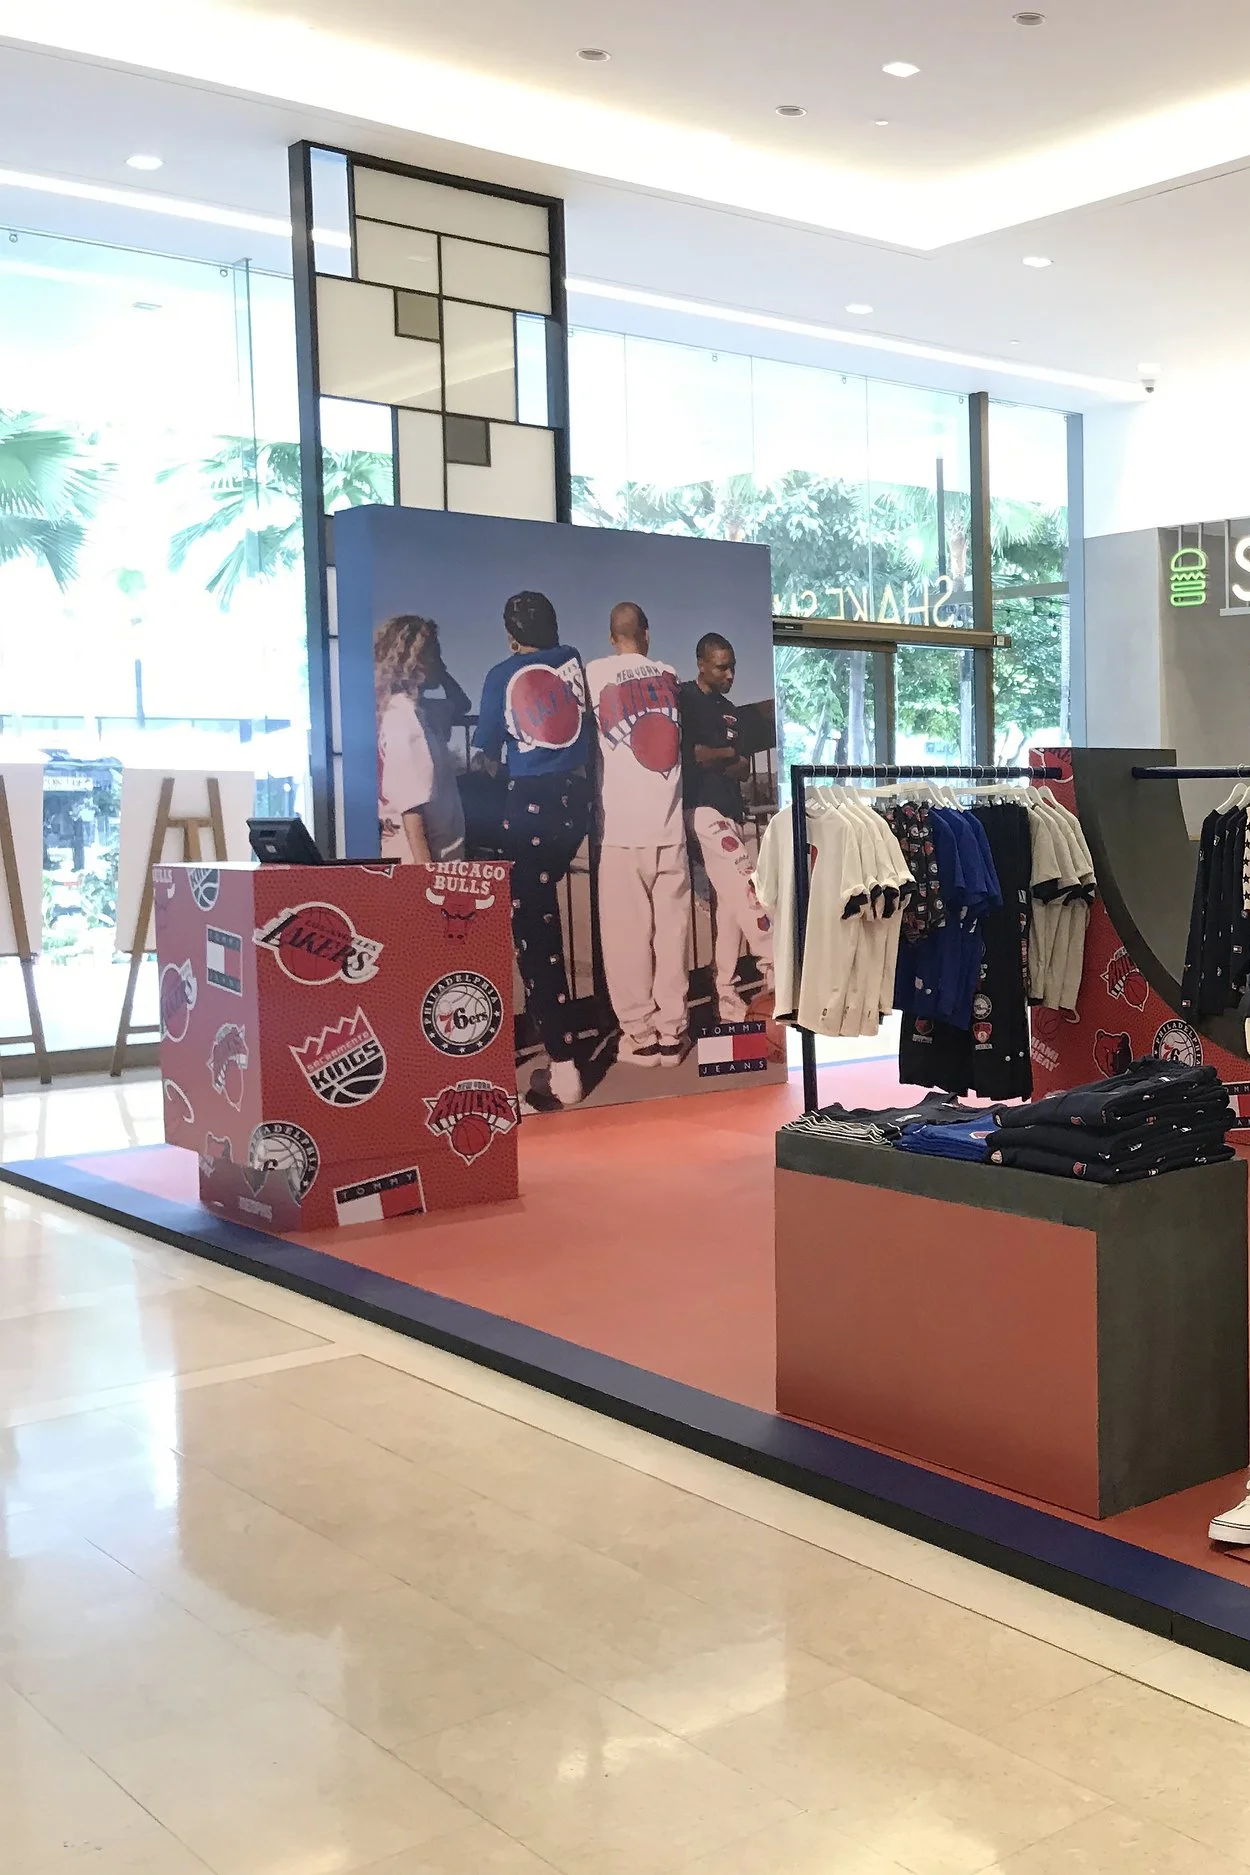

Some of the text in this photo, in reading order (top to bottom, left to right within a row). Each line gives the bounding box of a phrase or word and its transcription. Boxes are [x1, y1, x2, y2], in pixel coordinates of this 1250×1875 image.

[425, 861, 506, 881] CHICAGO
[433, 875, 491, 895] BULLS
[261, 912, 375, 979] LAKERS
[424, 974, 500, 1026] PHILADELPHIA
[438, 1007, 488, 1034] 76ers
[702, 1023, 762, 1036] TOMMY
[310, 1039, 381, 1090] KINGS
[703, 1060, 764, 1075] JEANS
[341, 1172, 414, 1200] TOMMY
